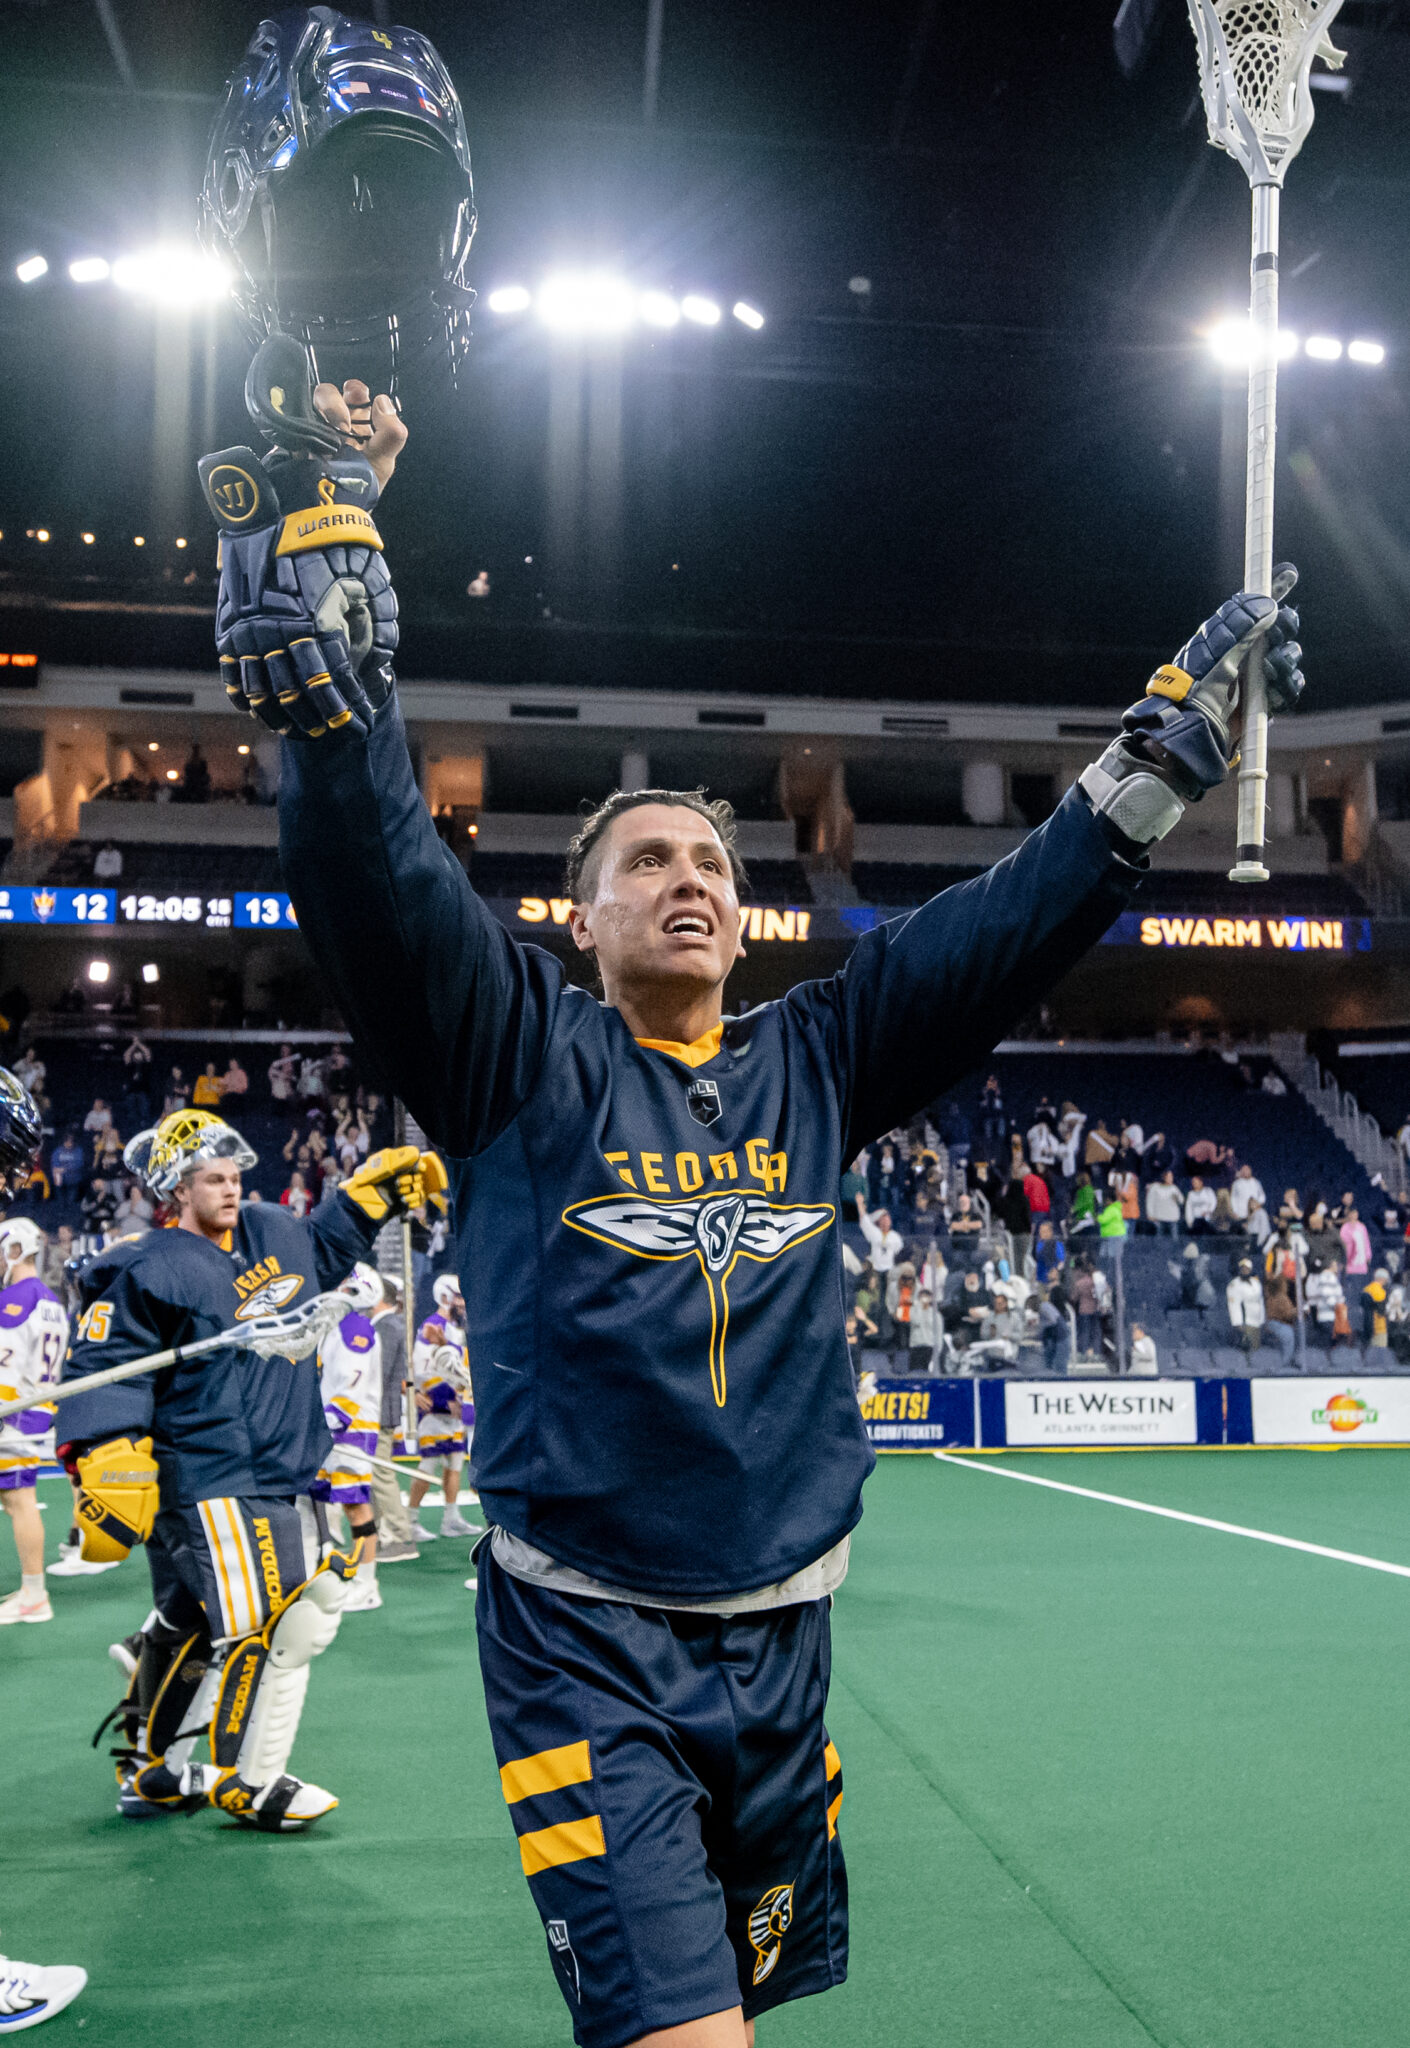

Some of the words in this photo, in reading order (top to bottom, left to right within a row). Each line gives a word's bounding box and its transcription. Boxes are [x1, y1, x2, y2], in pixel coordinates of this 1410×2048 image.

[371, 30, 393, 50] 4
[72, 894, 108, 921] 12
[121, 895, 202, 922] 12:05
[246, 898, 280, 924] 13
[1140, 917, 1262, 947] SWARM
[1266, 920, 1343, 949] WIN!
[688, 1082, 715, 1096] NLL
[1028, 1393, 1076, 1415] THE
[1079, 1393, 1174, 1415] WESTIN
[1044, 1423, 1097, 1434] ATLANTA
[1101, 1422, 1160, 1434] GWINNETT
[252, 1517, 284, 1613] BODDAM
[225, 1654, 259, 1734] BODDAM
